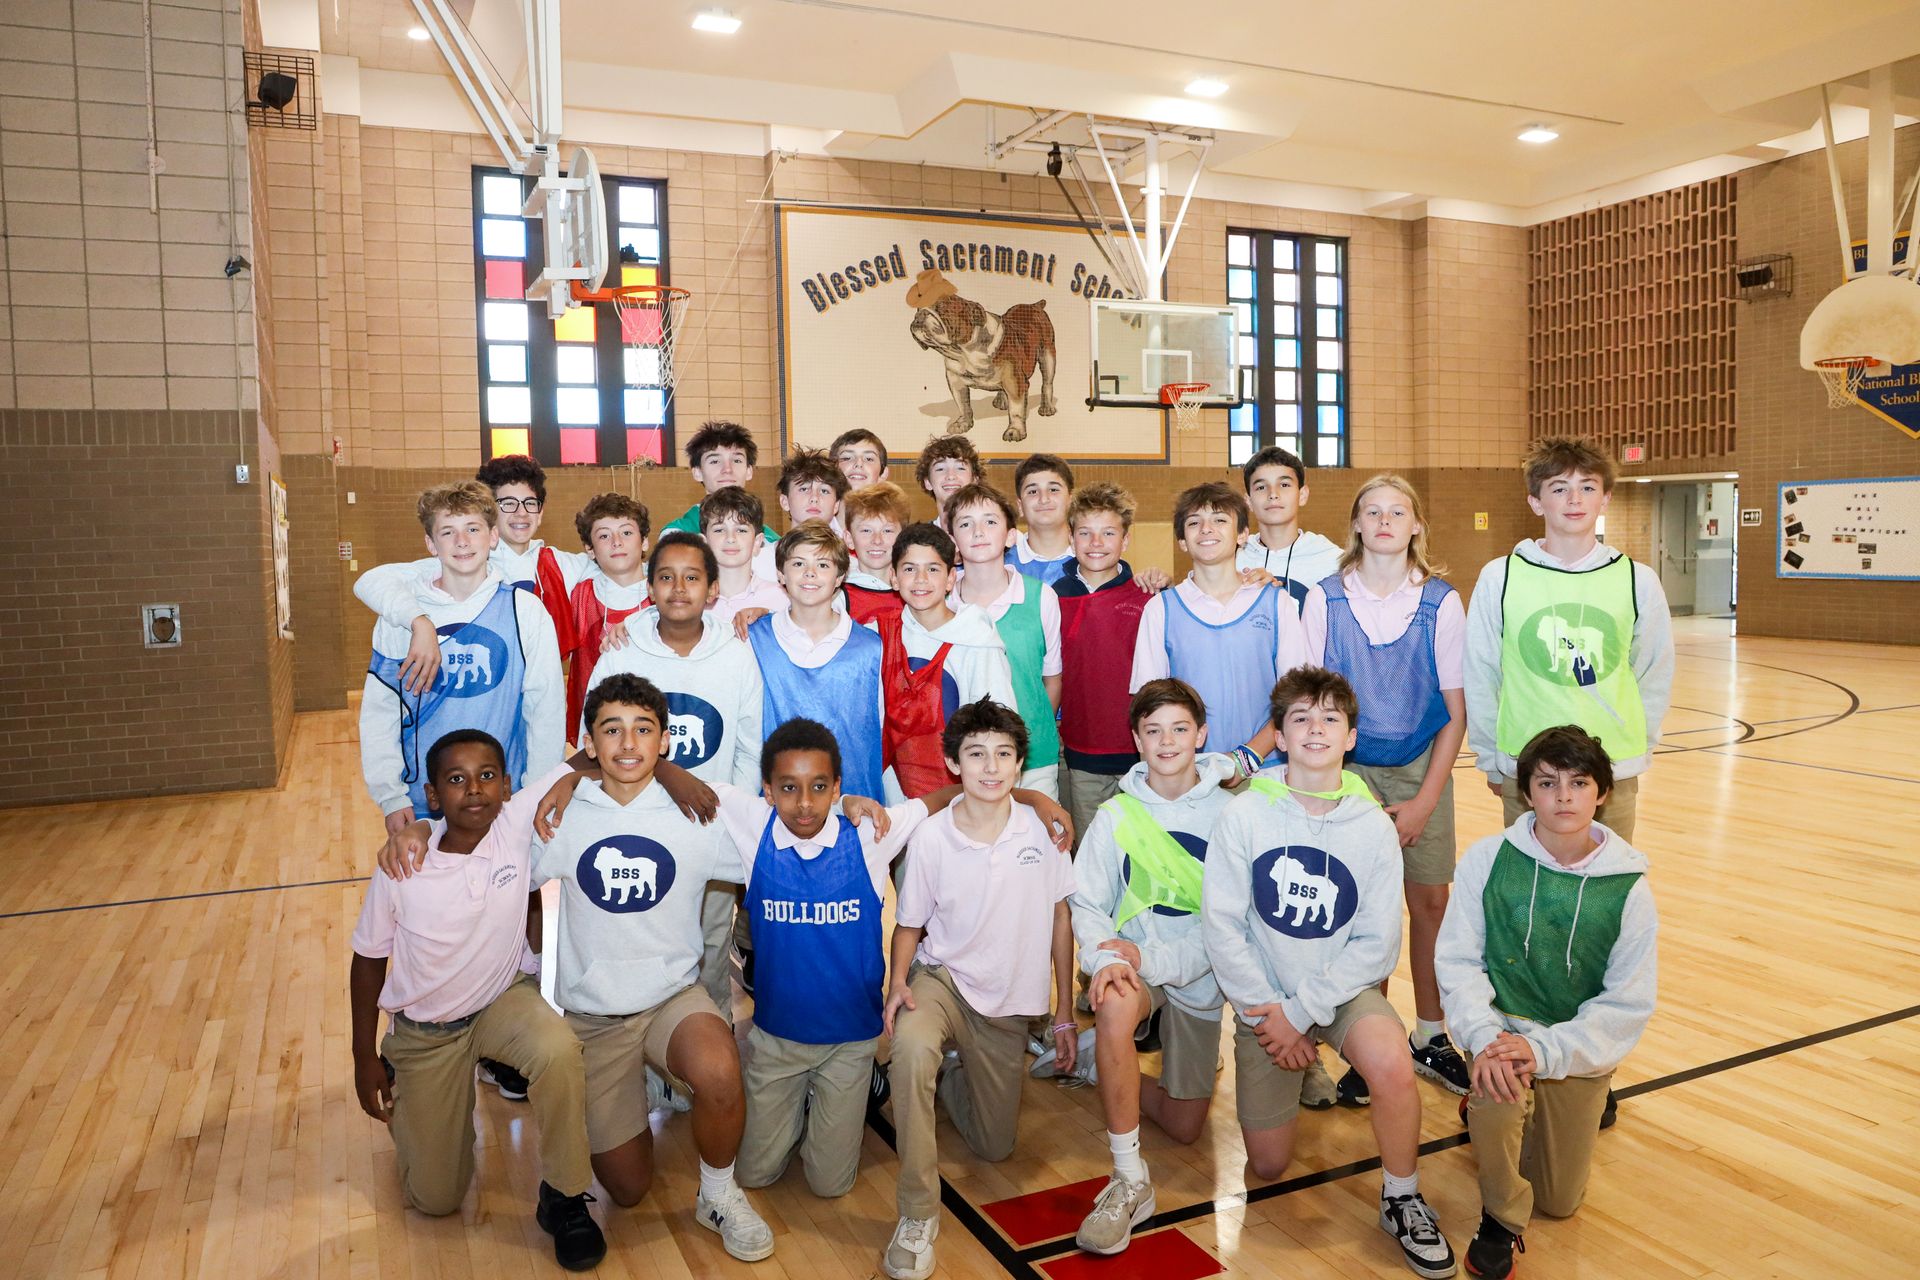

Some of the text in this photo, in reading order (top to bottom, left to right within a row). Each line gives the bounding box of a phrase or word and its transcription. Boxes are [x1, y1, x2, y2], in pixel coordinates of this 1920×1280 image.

[801, 244, 907, 313] Blessed
[919, 239, 1056, 284] Sacrament
[447, 653, 474, 665] BSS
[668, 724, 688, 736] SS
[610, 867, 641, 880] BSS
[1287, 881, 1319, 900] BSS
[762, 899, 860, 925] BULLDOGS
